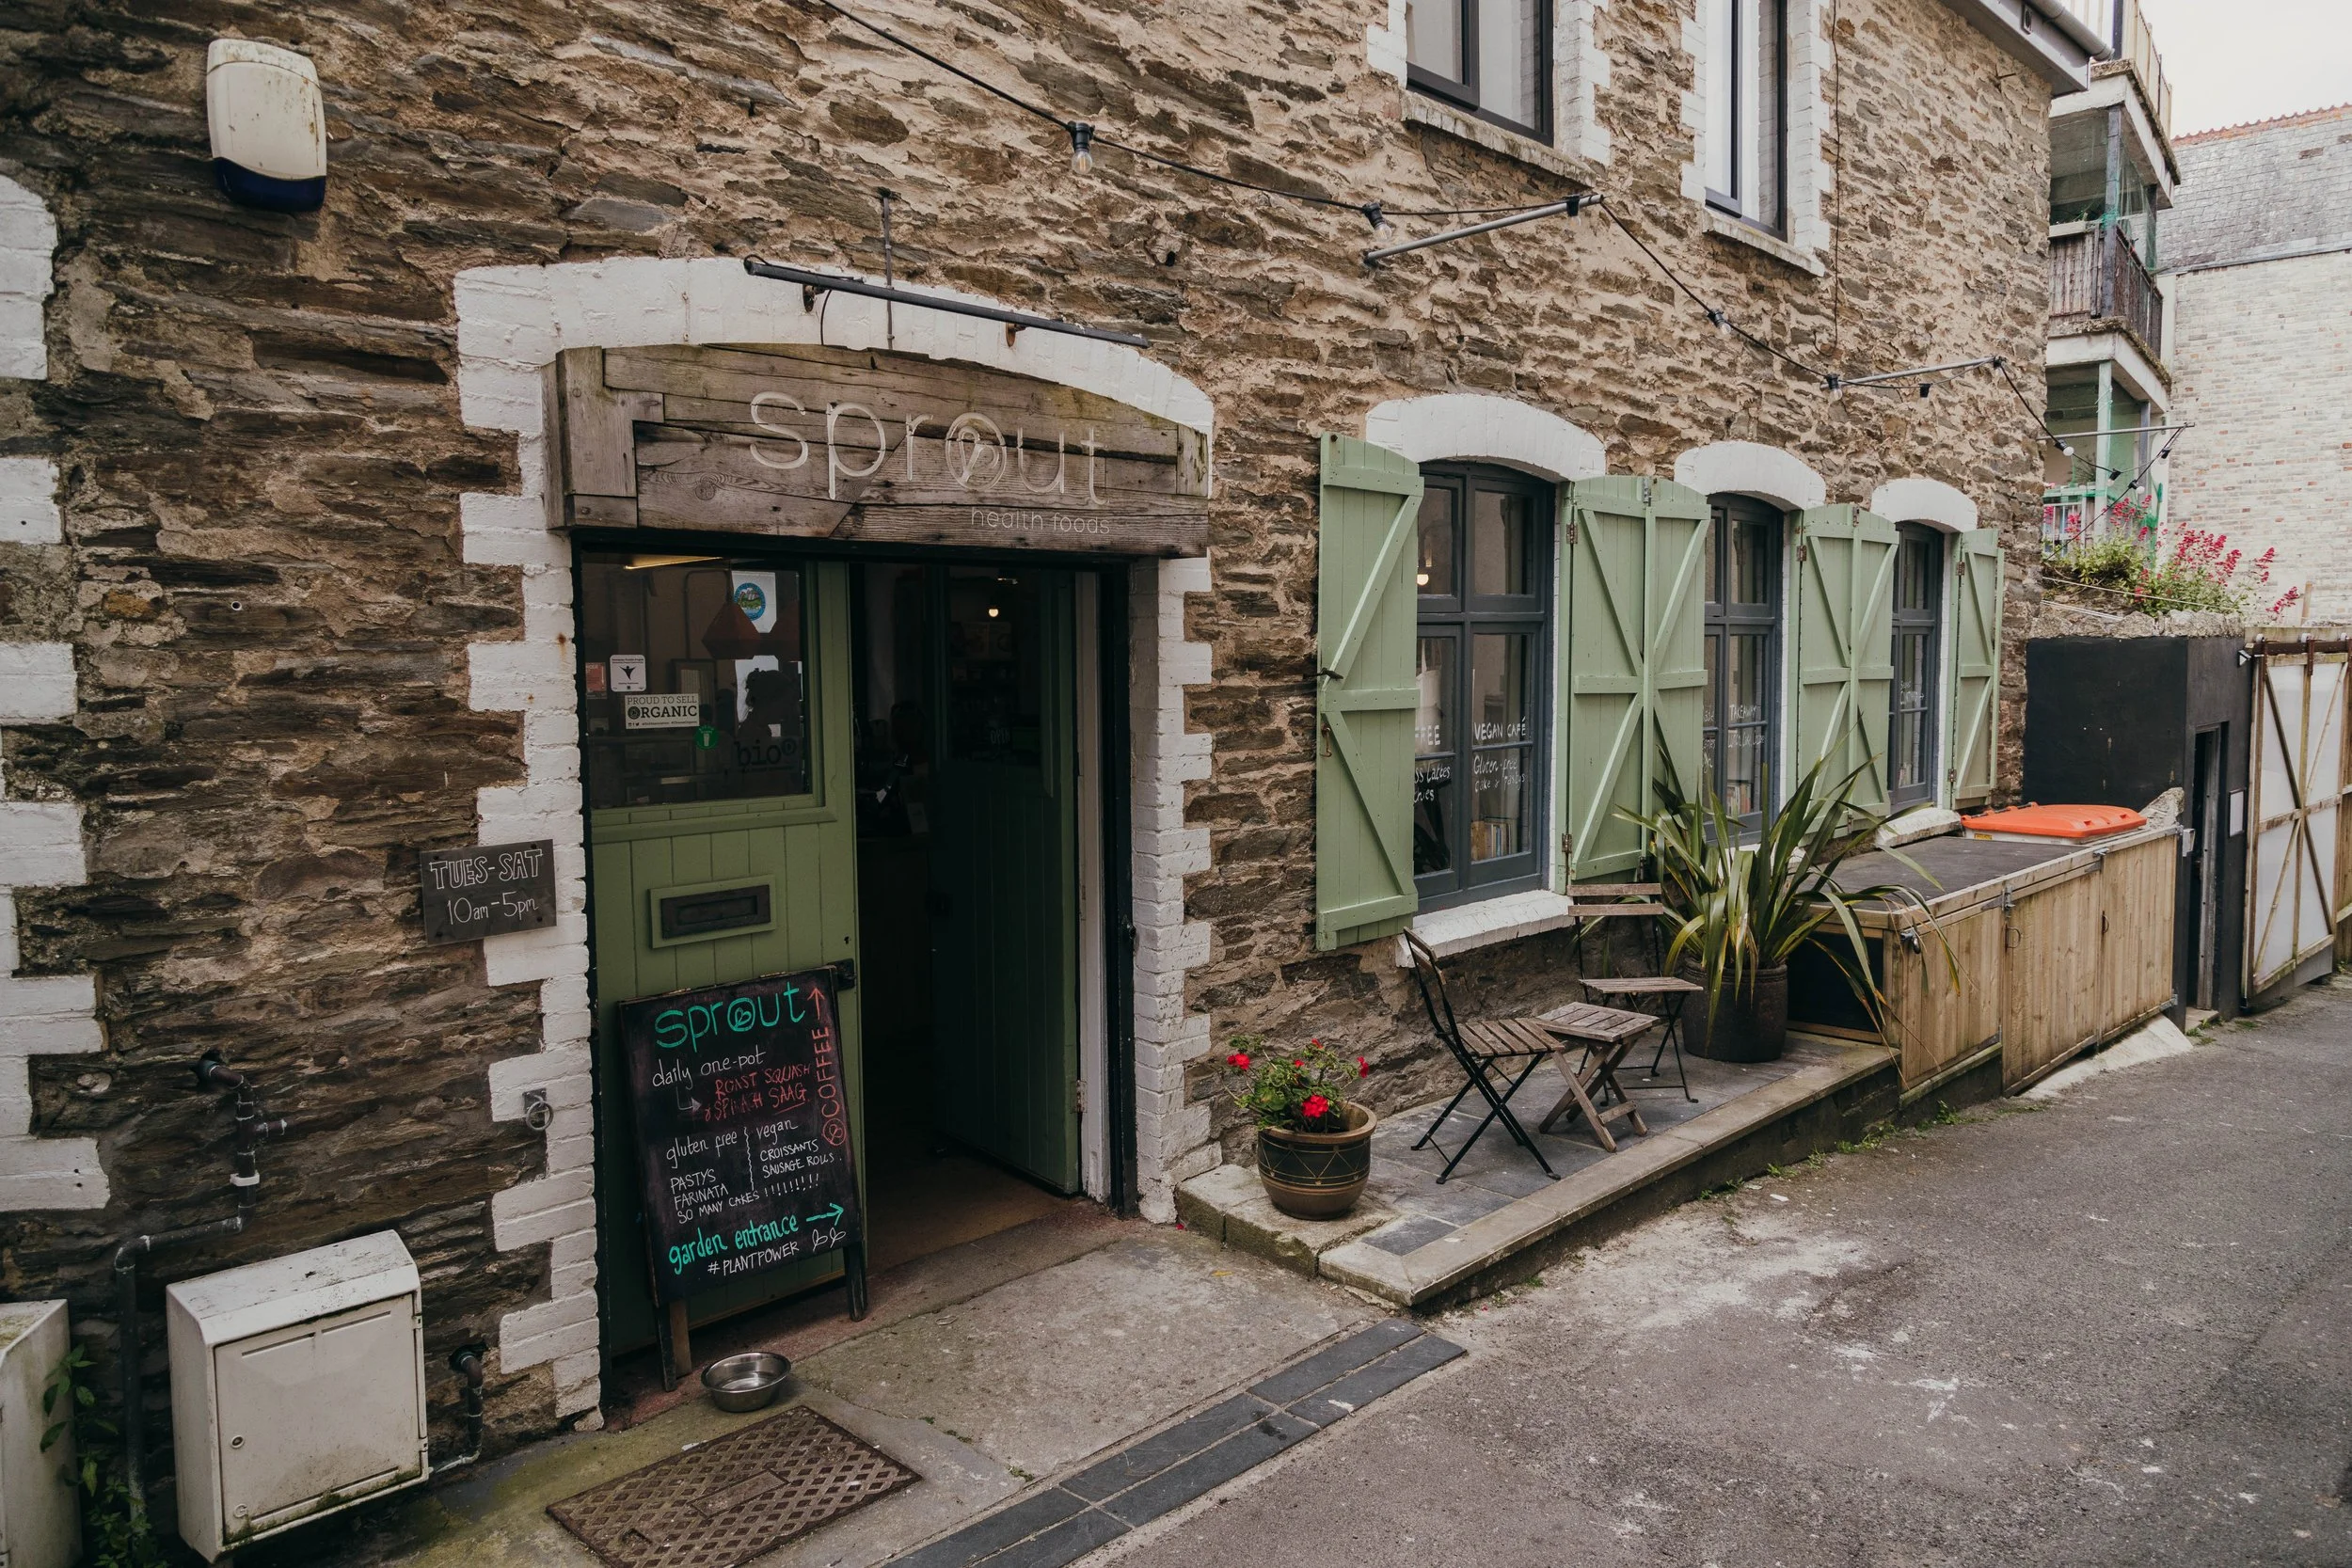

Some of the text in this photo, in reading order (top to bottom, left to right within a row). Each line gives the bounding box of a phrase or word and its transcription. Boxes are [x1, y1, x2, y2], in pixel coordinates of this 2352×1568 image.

[750, 391, 1110, 506] sprout
[971, 506, 1110, 534] health foods
[627, 695, 697, 705] PROUD TO SELL
[627, 705, 697, 721] ORGANIC
[1473, 716, 1526, 741] VEGAN CAFÉ
[1426, 762, 1451, 783] Lattes
[652, 1044, 767, 1091] daily one-pot
[811, 1026, 840, 1118] COFFEE
[715, 1063, 811, 1101] ROAST SQUASH
[755, 1119, 799, 1146] vegan
[666, 1131, 738, 1168] gluten free
[759, 1138, 819, 1163] CROISSANTS
[670, 1168, 716, 1195] PASTYS
[762, 1159, 805, 1179] SAUSAGE
[674, 1183, 729, 1212] FARINATA
[677, 1209, 693, 1224] SO
[699, 1201, 723, 1217] MANY
[728, 1190, 760, 1207] CAKES
[669, 1213, 800, 1275] garden entrance
